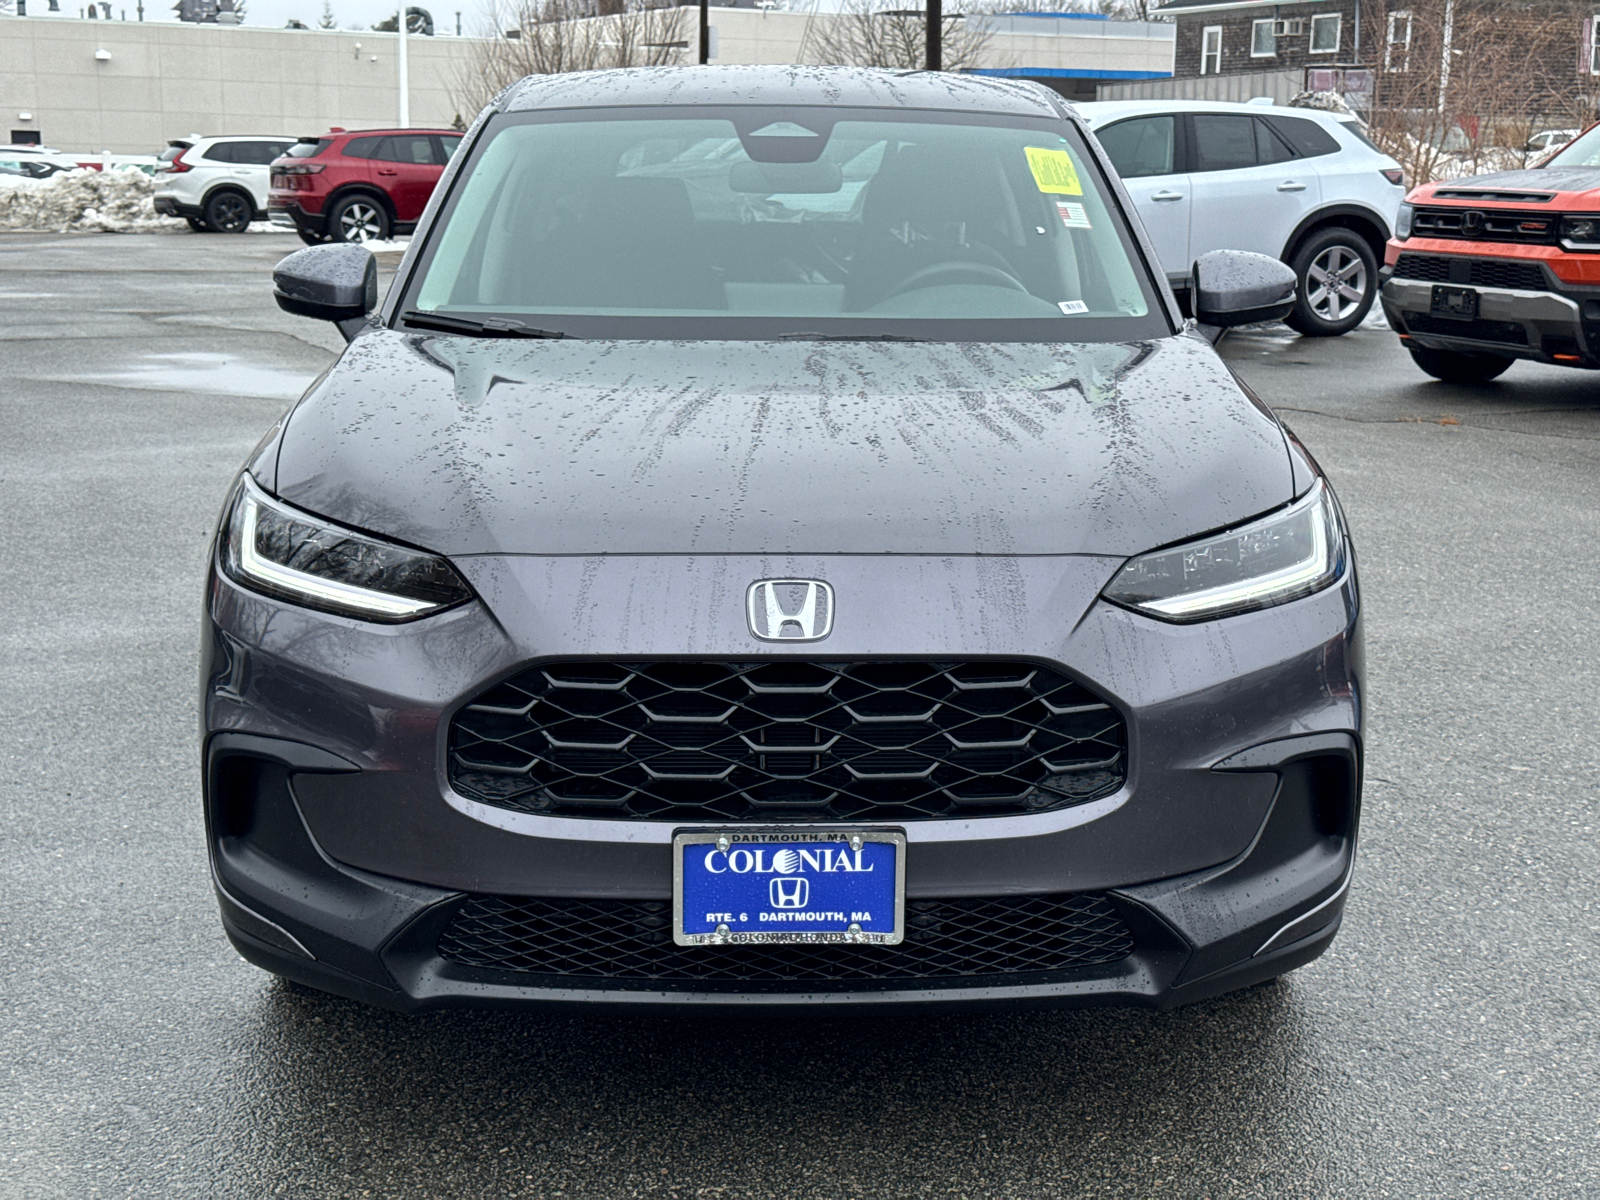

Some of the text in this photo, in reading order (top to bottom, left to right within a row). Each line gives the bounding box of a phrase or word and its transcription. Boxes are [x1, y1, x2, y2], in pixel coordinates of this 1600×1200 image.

[827, 833, 848, 842] MA
[704, 848, 874, 875] COLONIAL
[706, 911, 872, 923] RTE. 6 DARTMOUTH, MA
[800, 932, 847, 943] HONDA
